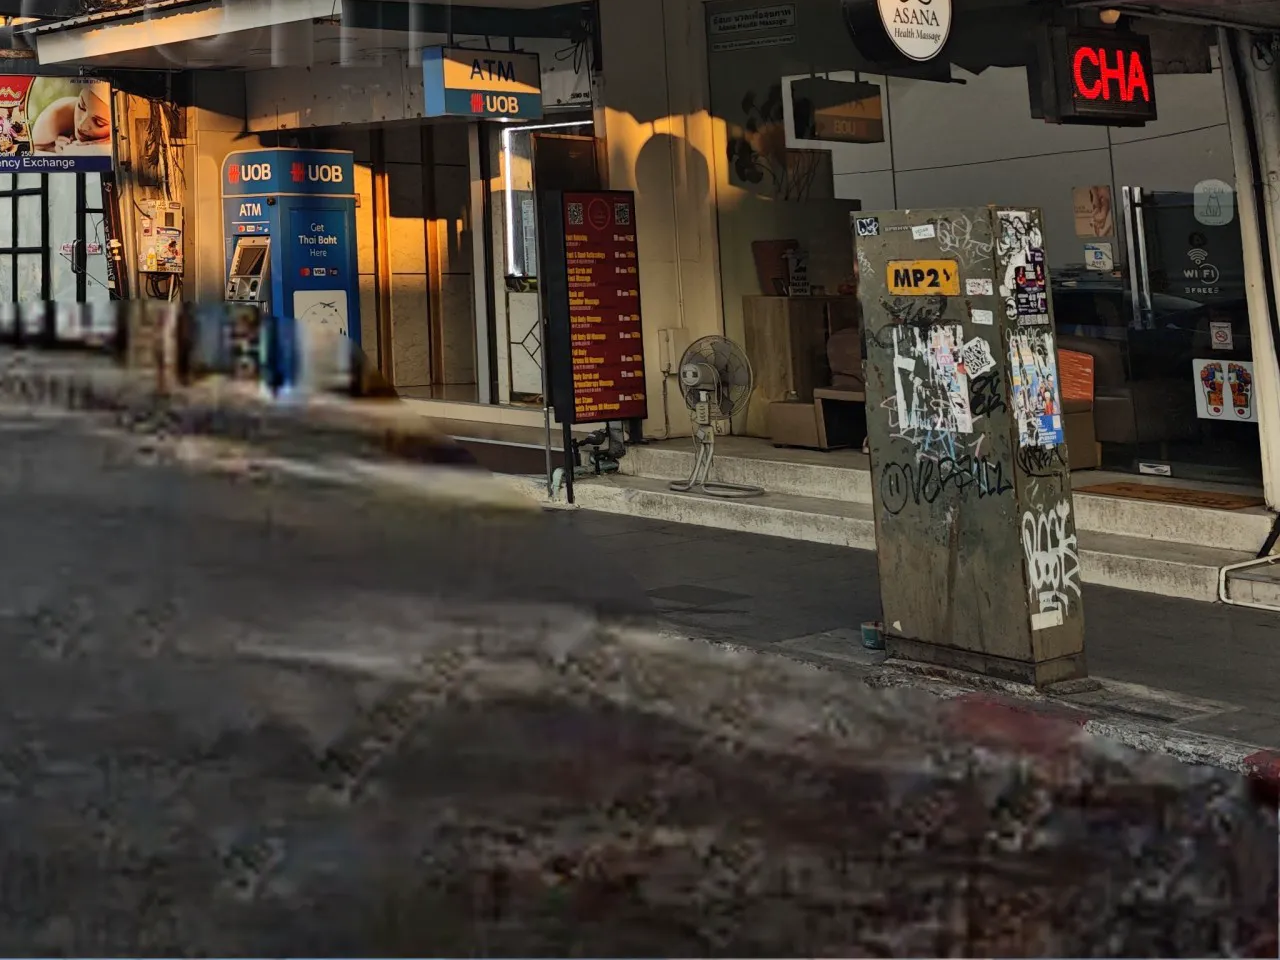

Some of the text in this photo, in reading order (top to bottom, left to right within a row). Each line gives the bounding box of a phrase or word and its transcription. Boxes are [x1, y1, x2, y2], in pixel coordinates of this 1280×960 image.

[893, 7, 940, 27] ASANA
[894, 27, 941, 44] Health Massage
[470, 58, 516, 83] ATM
[1074, 46, 1149, 101] CHA
[486, 95, 520, 114] UOB
[23, 157, 75, 169] Exchange
[241, 163, 343, 183] UOB UOB
[239, 203, 262, 217] ATM
[310, 222, 325, 233] Get
[298, 235, 338, 245] Thai Baht
[309, 249, 328, 257] Here
